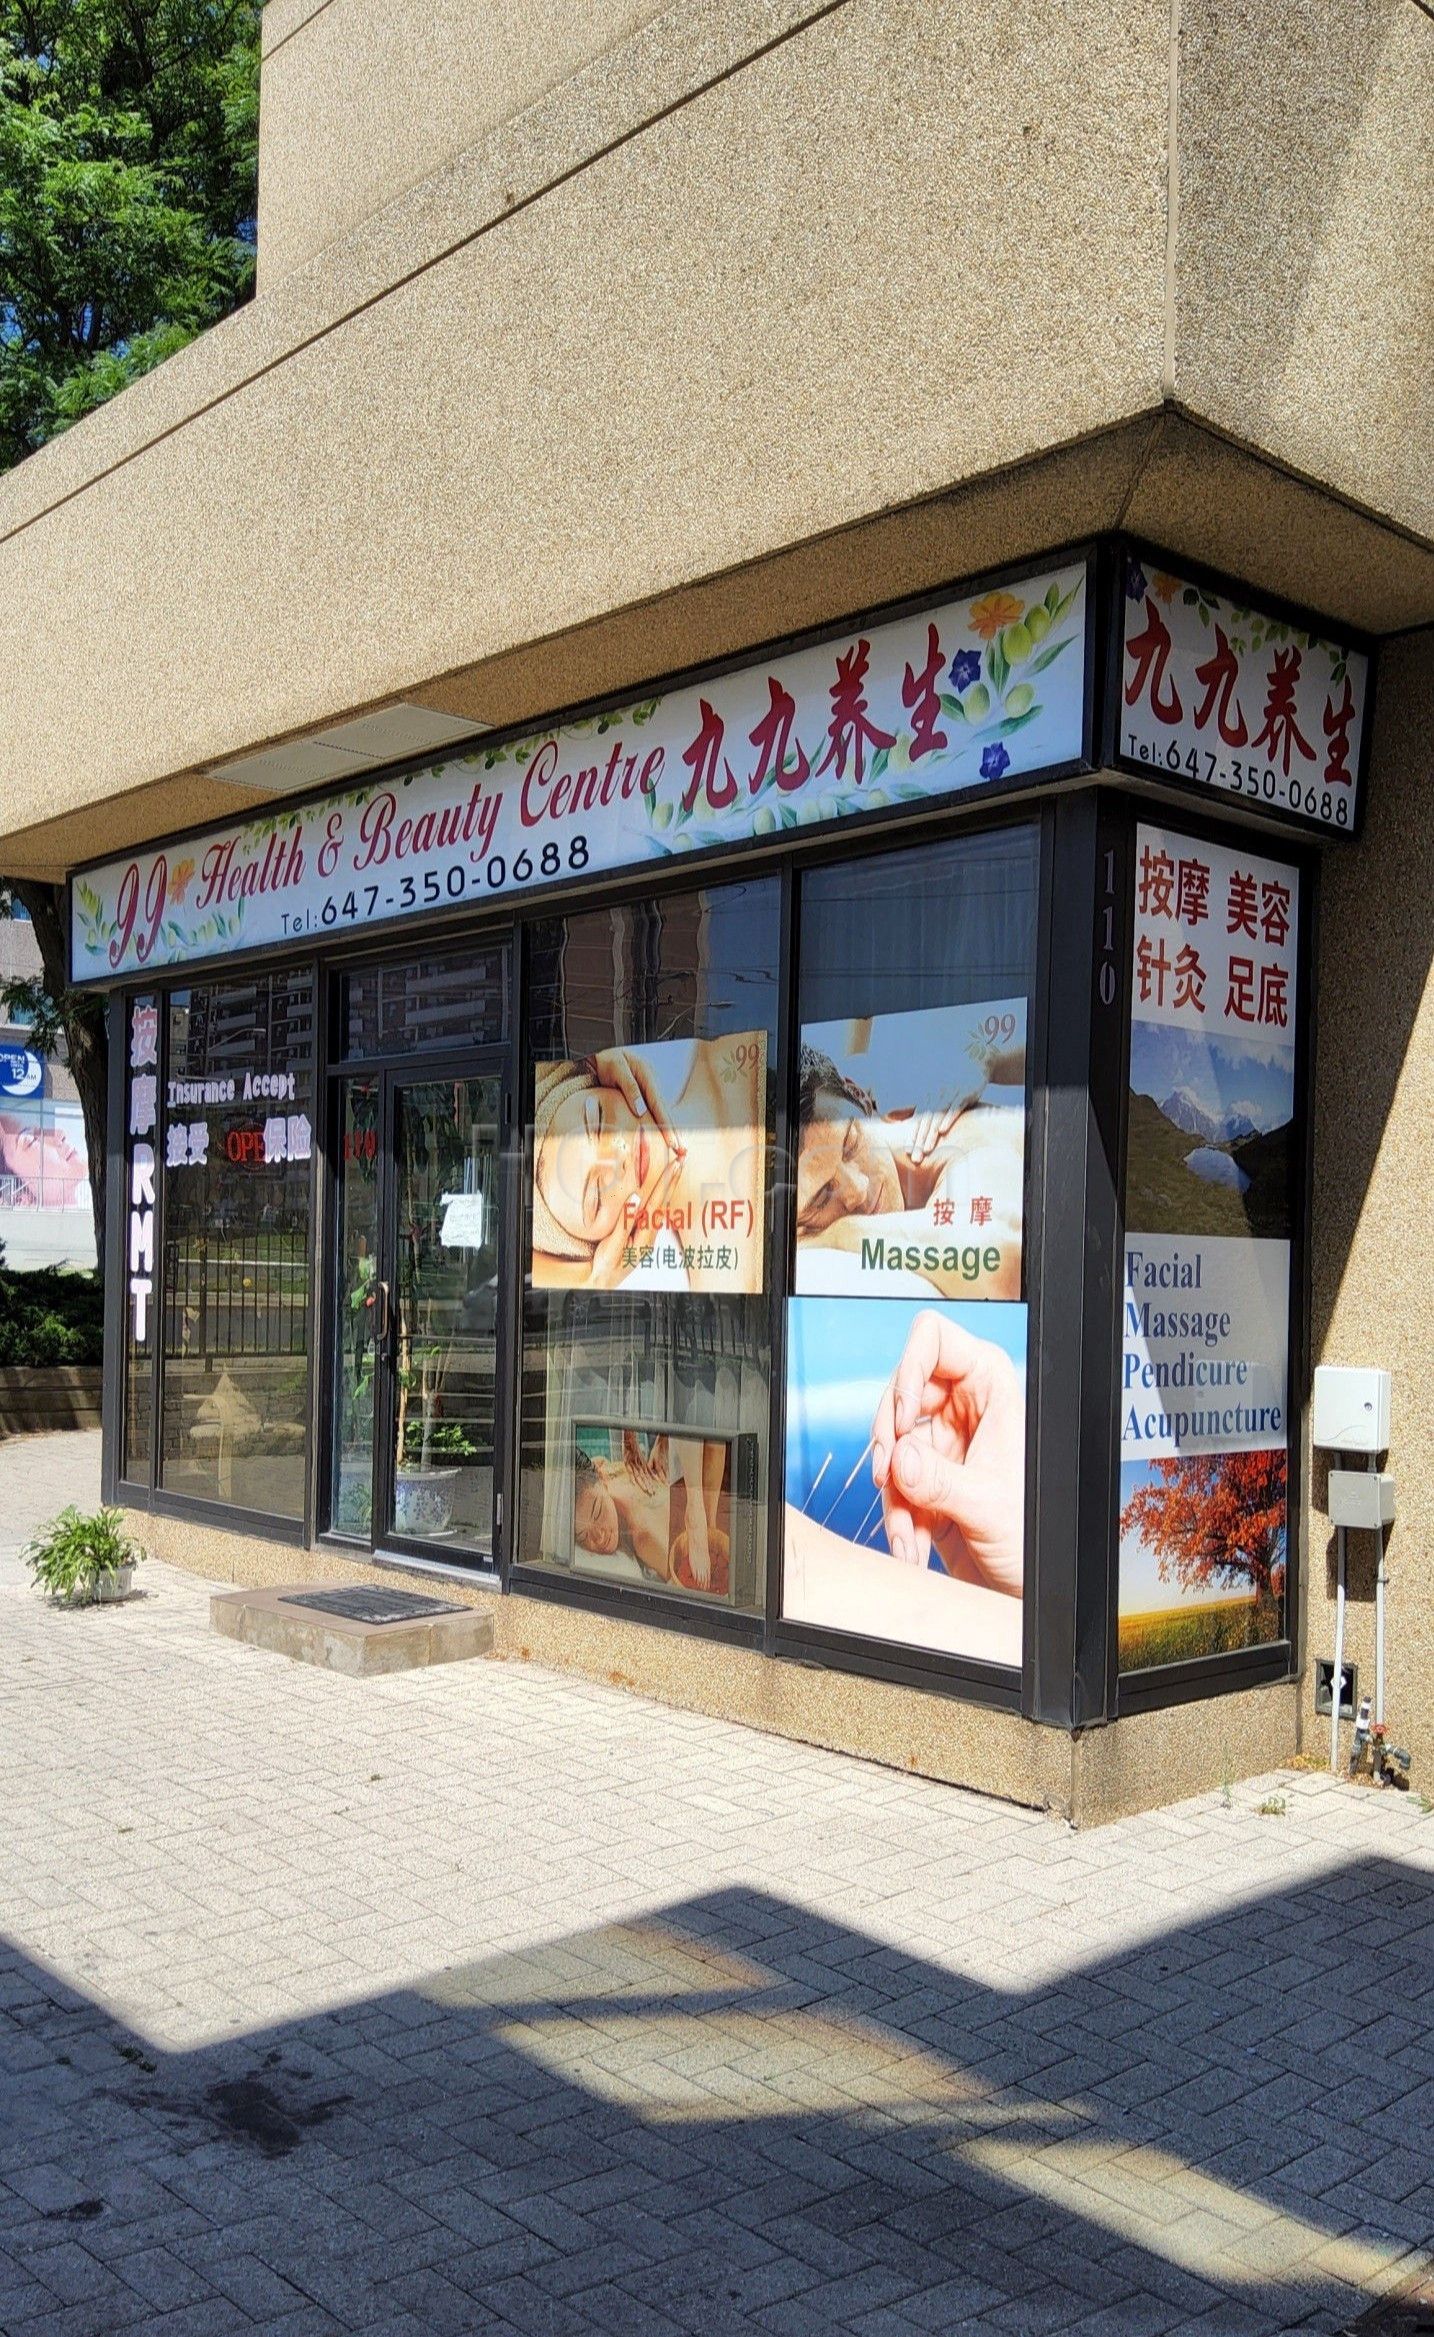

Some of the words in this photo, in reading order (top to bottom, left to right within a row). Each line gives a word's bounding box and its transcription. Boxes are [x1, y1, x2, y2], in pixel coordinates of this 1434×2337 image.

[1124, 595, 1357, 787] 九九养生
[682, 622, 951, 811] 九九养生
[196, 826, 306, 910] Health
[317, 813, 344, 878] &
[353, 783, 504, 871] Beauty
[520, 740, 666, 828] Centre
[1138, 845, 1210, 926] 按摩
[1226, 870, 1290, 947] 美容
[1136, 934, 1207, 1013] 针灸
[1224, 956, 1288, 1028] 足底
[984, 1013, 1016, 1045] 99
[12, 1068, 25, 1080] 12
[167, 1079, 235, 1108] Insurance
[243, 1072, 296, 1100] Accept
[227, 1130, 265, 1162] OPE
[623, 1202, 692, 1231] Facial
[701, 1200, 755, 1238] (RF)
[131, 1143, 156, 1342] RMT
[861, 1238, 1001, 1281] Massage
[1124, 1251, 1203, 1289] Facial
[1123, 1302, 1231, 1347] Massage
[1122, 1352, 1248, 1389] Pendicure
[1121, 1402, 1282, 1448] Acupuncture
